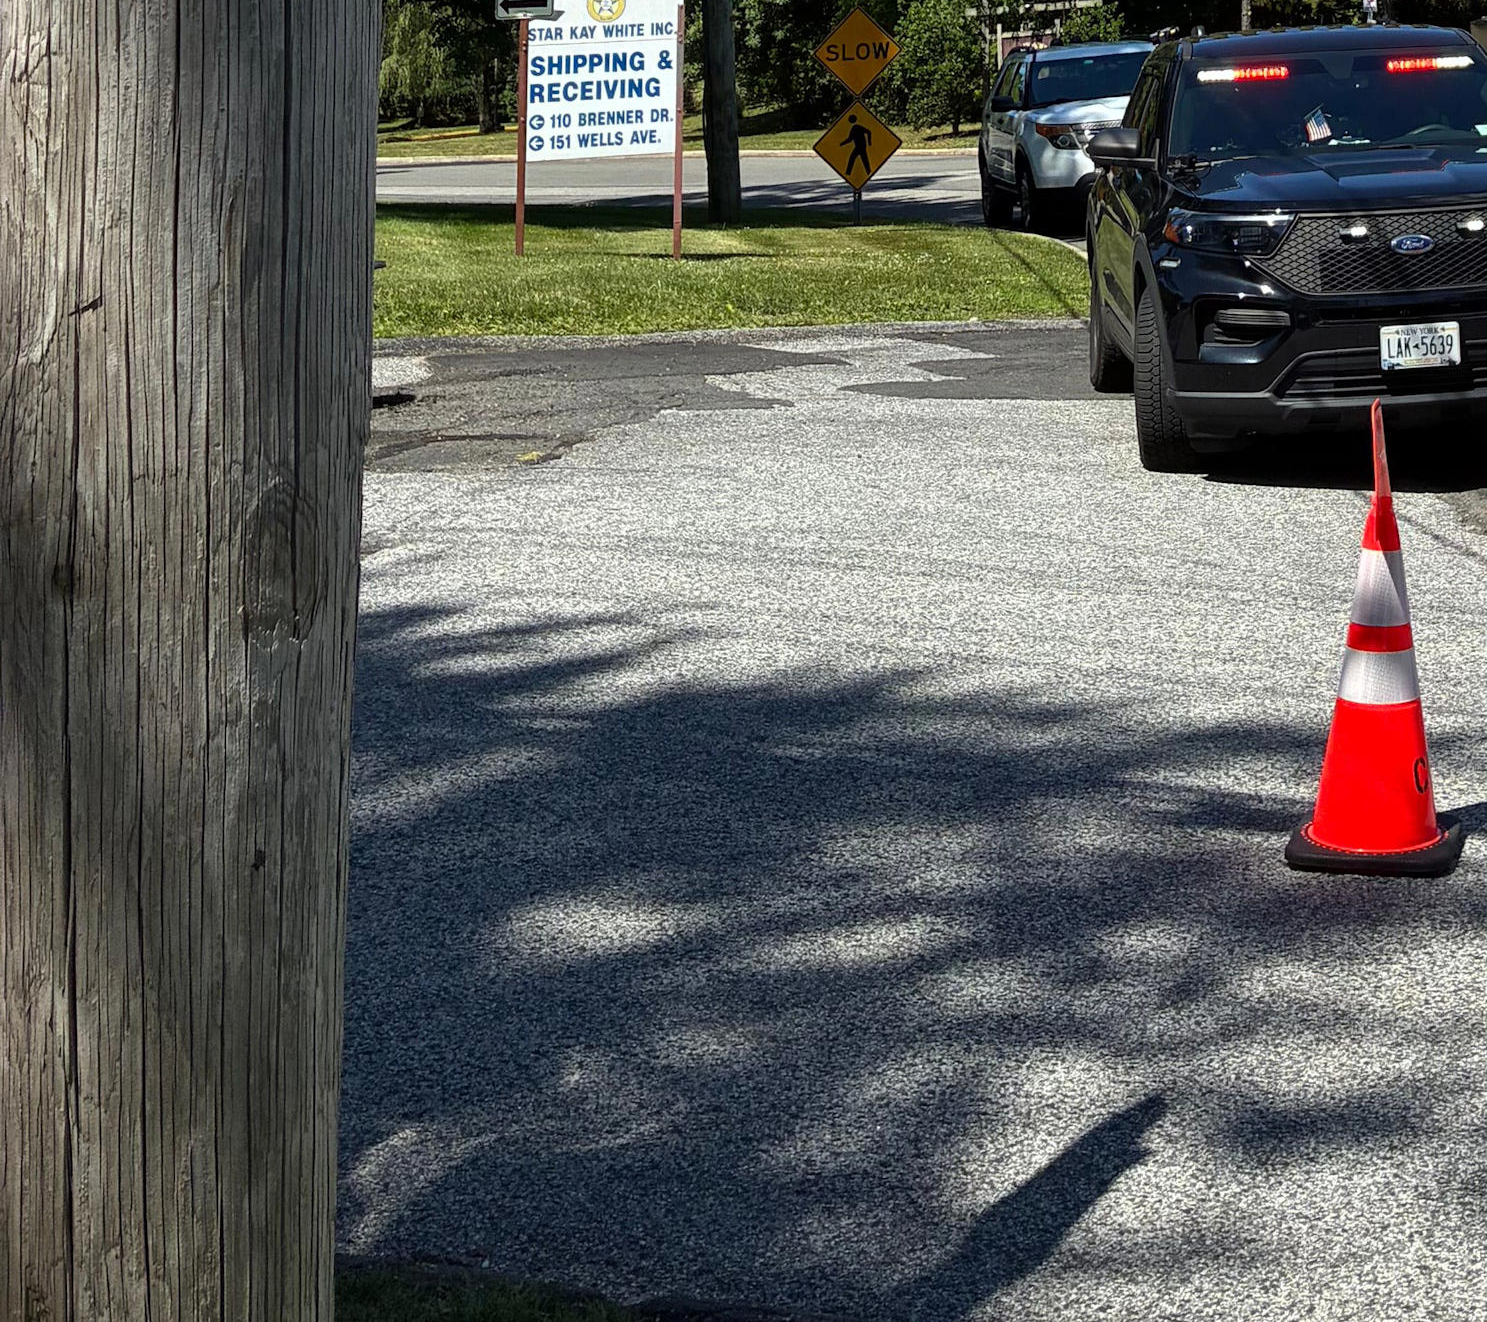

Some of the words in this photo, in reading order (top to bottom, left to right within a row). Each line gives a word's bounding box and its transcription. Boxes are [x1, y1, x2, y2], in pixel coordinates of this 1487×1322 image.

[528, 27, 563, 42] STAR
[570, 25, 597, 40] KAY
[603, 23, 645, 38] WHITE
[651, 21, 677, 36] INC.
[825, 41, 890, 62] SLOW
[530, 51, 645, 76] SHIPPING
[657, 49, 673, 70] &
[529, 77, 661, 103] RECEIVING
[550, 113, 571, 128] 110
[578, 109, 643, 127] BRENNER
[651, 108, 673, 123] DR.
[550, 134, 571, 149] 151
[578, 131, 623, 148] WELLS
[630, 129, 661, 145] AVE.
[1401, 328, 1418, 336] NEW
[1420, 327, 1440, 335] YORK
